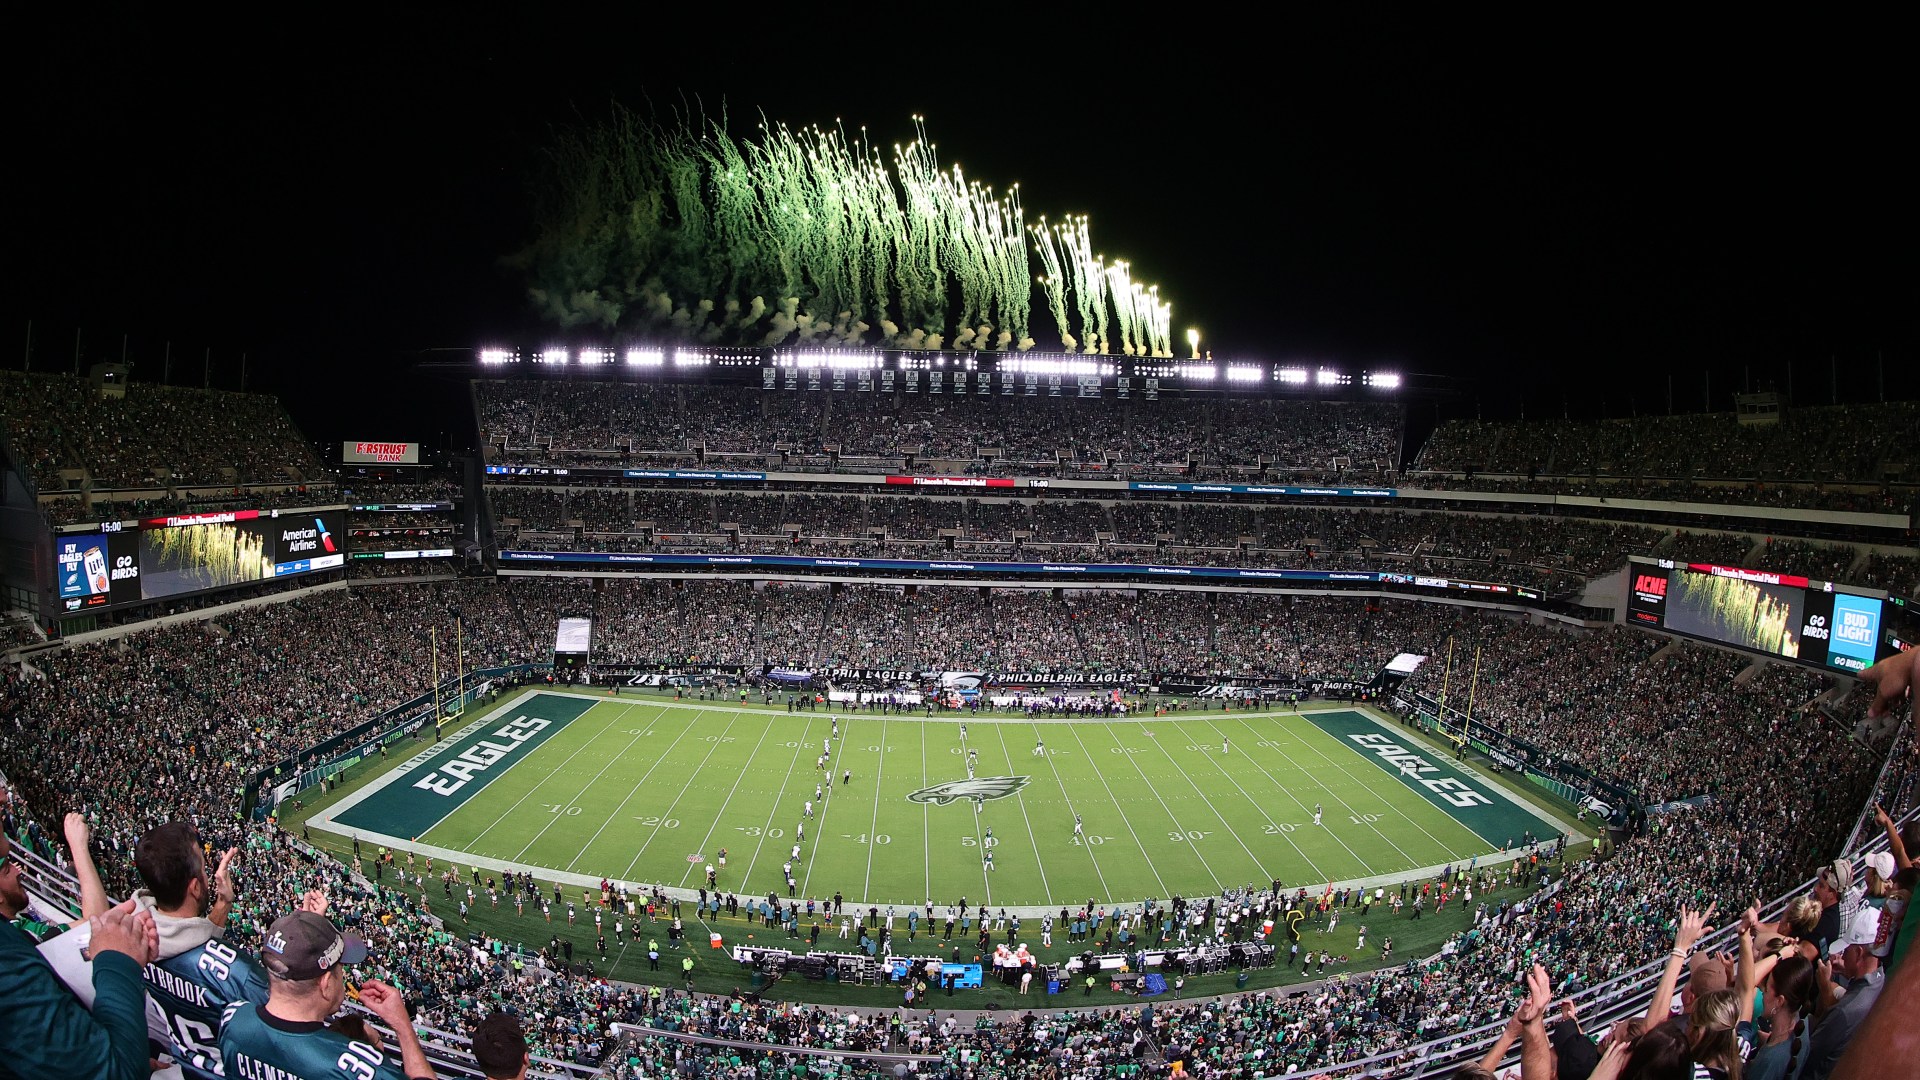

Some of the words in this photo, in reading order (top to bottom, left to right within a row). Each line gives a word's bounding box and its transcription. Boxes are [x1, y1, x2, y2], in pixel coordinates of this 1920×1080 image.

[174, 516, 196, 526] Lincoln
[196, 514, 220, 524] Financial
[220, 513, 235, 522] Field
[101, 522, 121, 532] 15:00
[282, 528, 316, 541] American
[64, 544, 76, 554] FLY
[290, 540, 316, 552] Airlines
[60, 552, 83, 563] EAGLES
[116, 555, 132, 568] GO
[1659, 559, 1674, 569] 15:00
[66, 562, 78, 572] FLY
[111, 566, 138, 580] BIRDS
[1718, 567, 1738, 578] Lincoln
[1738, 570, 1764, 582] Financial
[1764, 574, 1779, 584] Field
[1635, 575, 1667, 595] ACME
[1637, 612, 1657, 622] moderna
[1810, 614, 1825, 626] GO
[1844, 612, 1868, 628] BUD
[1803, 625, 1829, 640] BIRDS
[1837, 624, 1871, 642] LIGHT
[1834, 657, 1845, 665] GO
[1845, 659, 1866, 670] BIRDS
[1000, 674, 1084, 682] PHILADELPHIA
[1090, 674, 1133, 682] EAGLES
[363, 740, 383, 756] EAGL
[385, 730, 403, 744] AUTISM
[404, 717, 426, 735] FOUNDAT
[412, 745, 445, 764] TAKES
[412, 715, 552, 796] EAGLES
[1471, 740, 1489, 755] AUTISM
[1489, 749, 1522, 771] FOUNDATIN
[1347, 734, 1494, 807] EAGLES
[548, 804, 582, 816] 10
[641, 816, 680, 829] 20
[1349, 813, 1378, 824] 10
[745, 826, 784, 839] 30
[1261, 823, 1295, 835] 20
[853, 834, 891, 844] 40
[1068, 835, 1104, 846] 40
[1168, 830, 1204, 842] 30
[198, 939, 237, 981] 36
[237, 1052, 304, 1080] CLEME
[338, 1040, 384, 1080] 30
